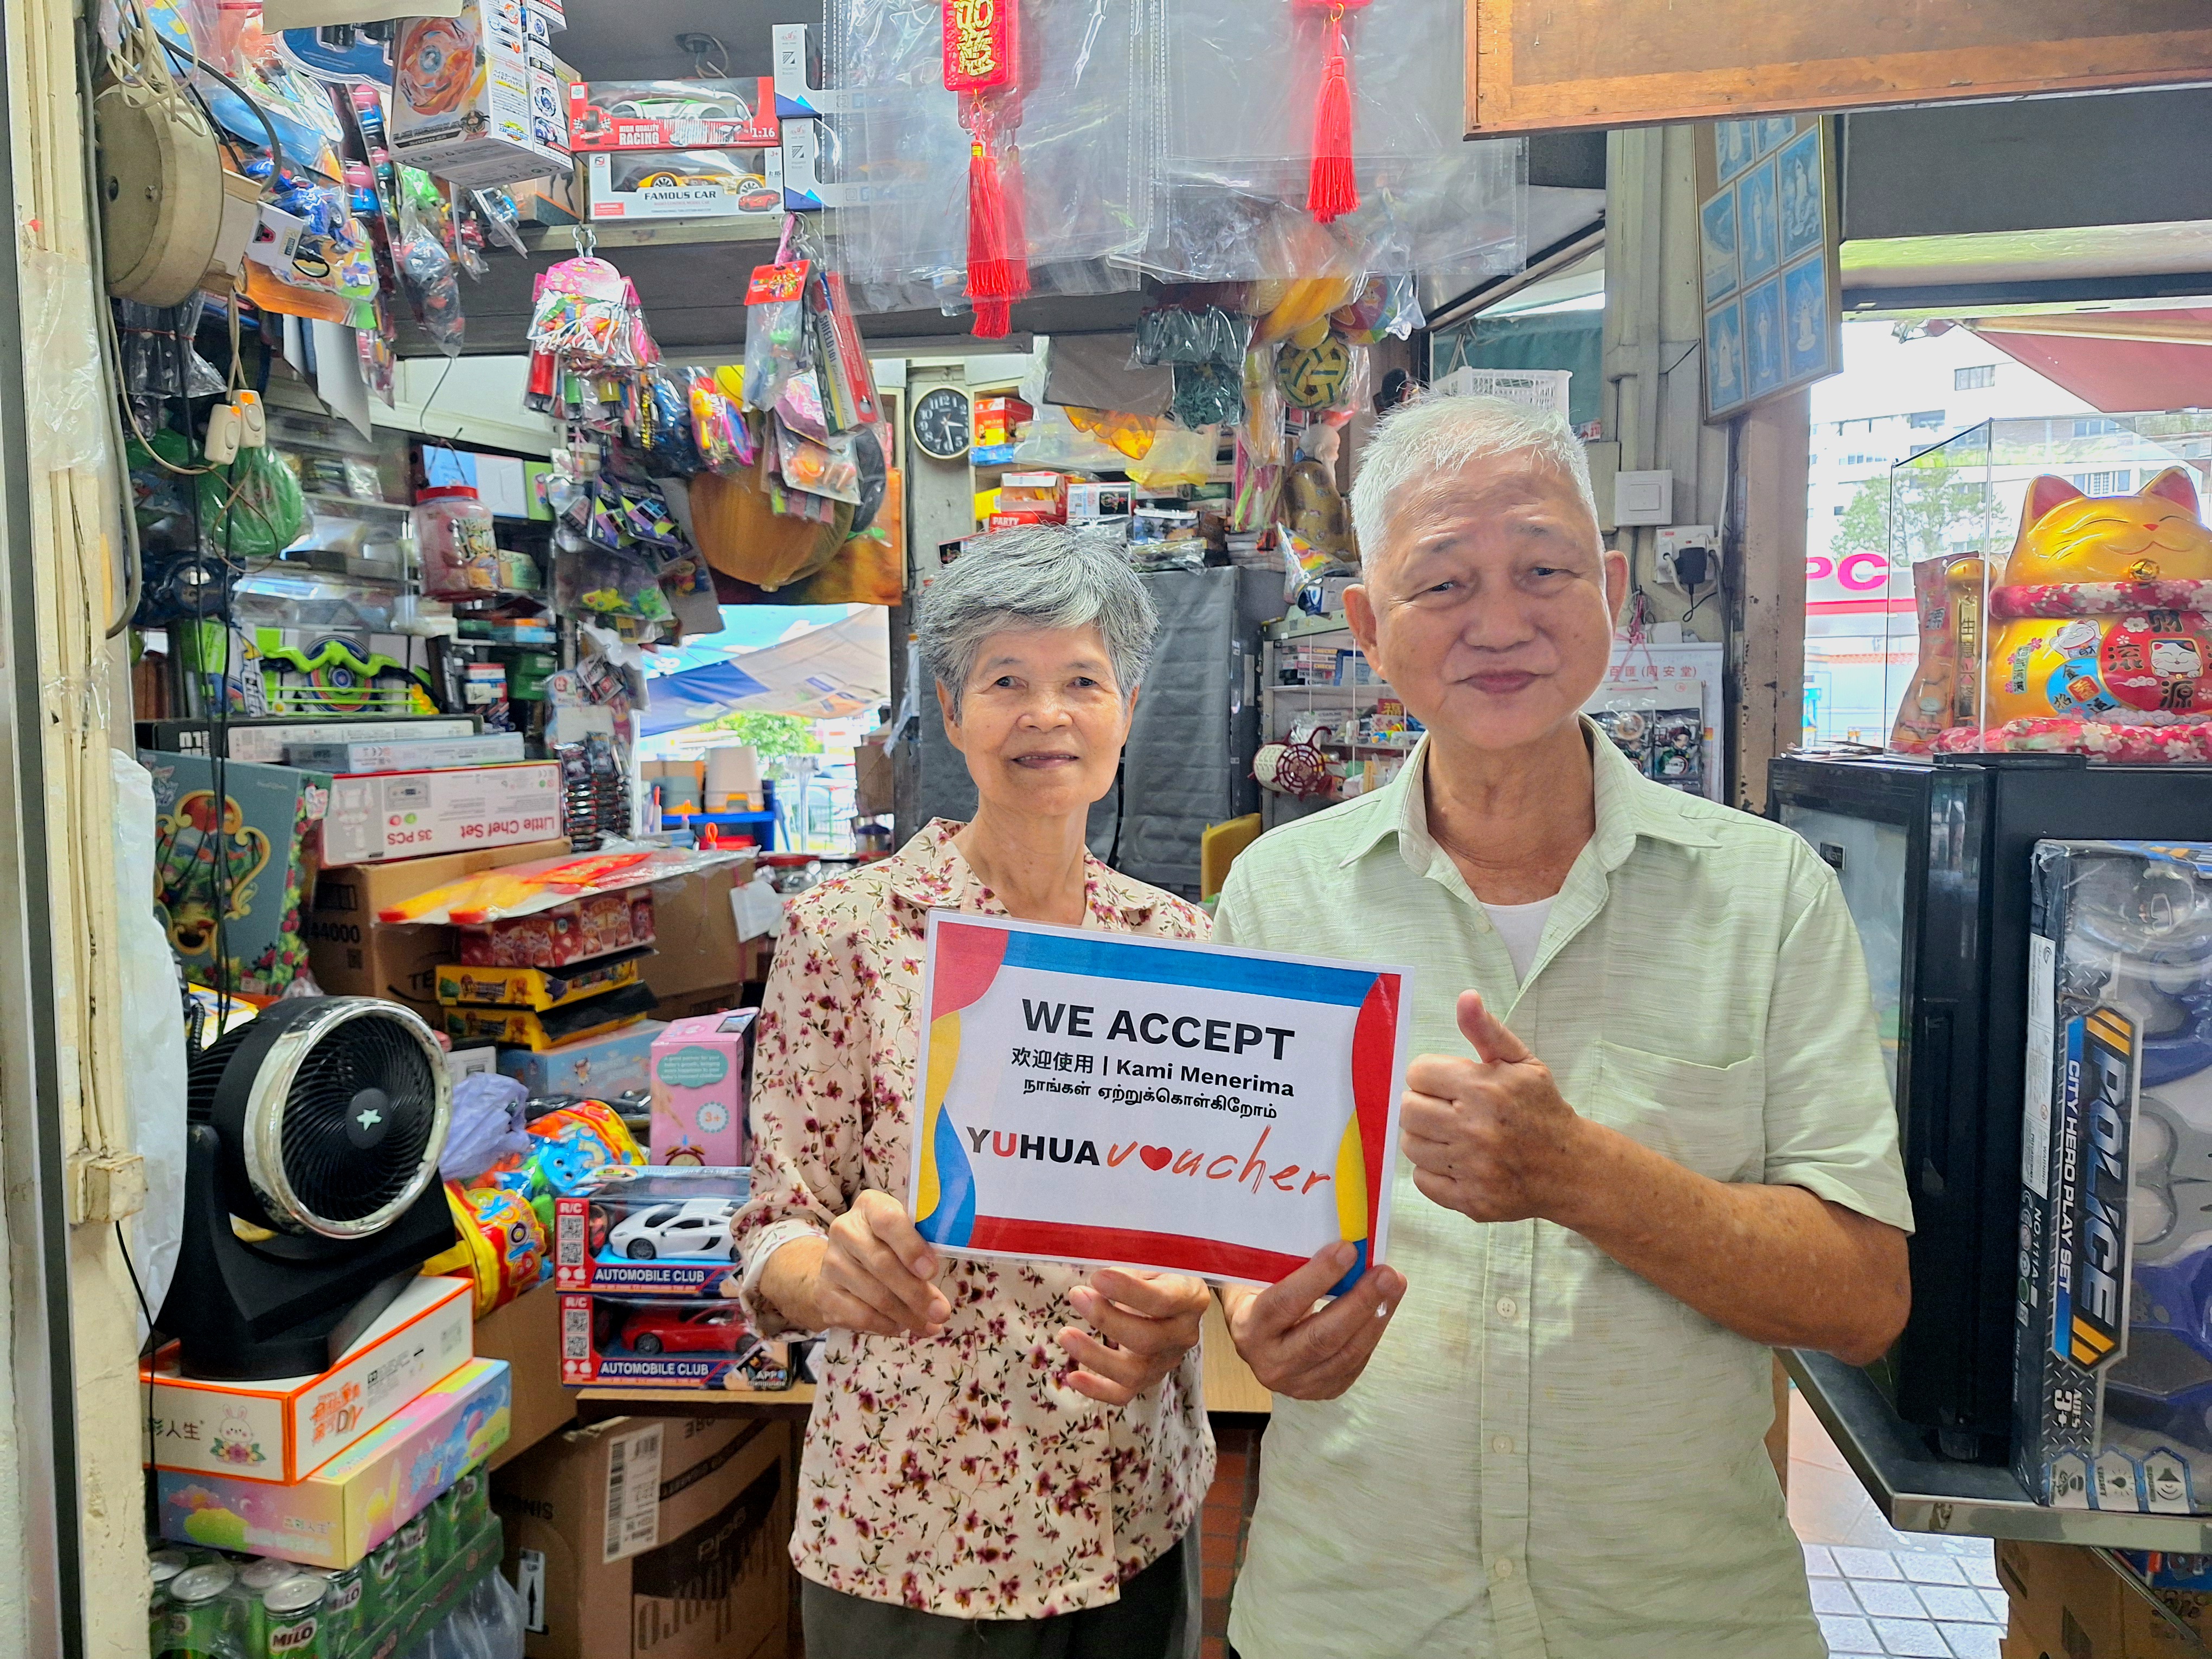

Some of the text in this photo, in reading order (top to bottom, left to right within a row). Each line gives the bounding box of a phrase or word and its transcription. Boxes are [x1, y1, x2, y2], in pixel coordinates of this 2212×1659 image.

[619, 132, 660, 145] RACING
[752, 127, 775, 138] 1:16
[644, 191, 716, 201] FAMOUS CAR
[819, 315, 835, 348] SHIELD
[828, 348, 837, 362] 101
[929, 398, 938, 409] 11
[939, 396, 950, 406] 12
[953, 397, 957, 407] 1
[919, 409, 933, 420] 10
[960, 404, 967, 415] 2
[921, 421, 928, 430] 9
[924, 432, 933, 441] 8
[955, 436, 963, 447] 5
[992, 517, 1019, 525] PARTY
[2062, 664, 2082, 681] 金
[2160, 679, 2195, 709] 源
[2054, 693, 2073, 710] 招
[461, 816, 556, 839] Little Chef Set
[387, 829, 432, 846] 35 PCS
[1021, 998, 1295, 1060] WE ACCEPT
[1011, 1047, 1094, 1074] 欢迎使用
[1116, 1059, 1173, 1081] Kami
[1180, 1065, 1295, 1098] Menerima
[1023, 1077, 1278, 1120] நாங்கள் ஏற்றுக்கொள்கிறோம்
[705, 1111, 721, 1123] 3+
[966, 1126, 1100, 1166] YUHUA
[2059, 1060, 2080, 1294] CITY HERO PLAY SET
[2081, 1045, 2127, 1327] POLICE
[560, 1203, 582, 1214] R/C
[595, 1269, 705, 1283] AUTOMOBILE CLUB
[565, 1296, 587, 1307] R/C
[600, 1362, 709, 1376] AUTOMOBILE CLUB
[756, 1372, 777, 1380] APP
[2054, 1389, 2073, 1428] 3+
[2072, 1388, 2082, 1428] AGES
[2097, 1465, 2108, 1497] LIGHT
[272, 1626, 313, 1647] MILO
